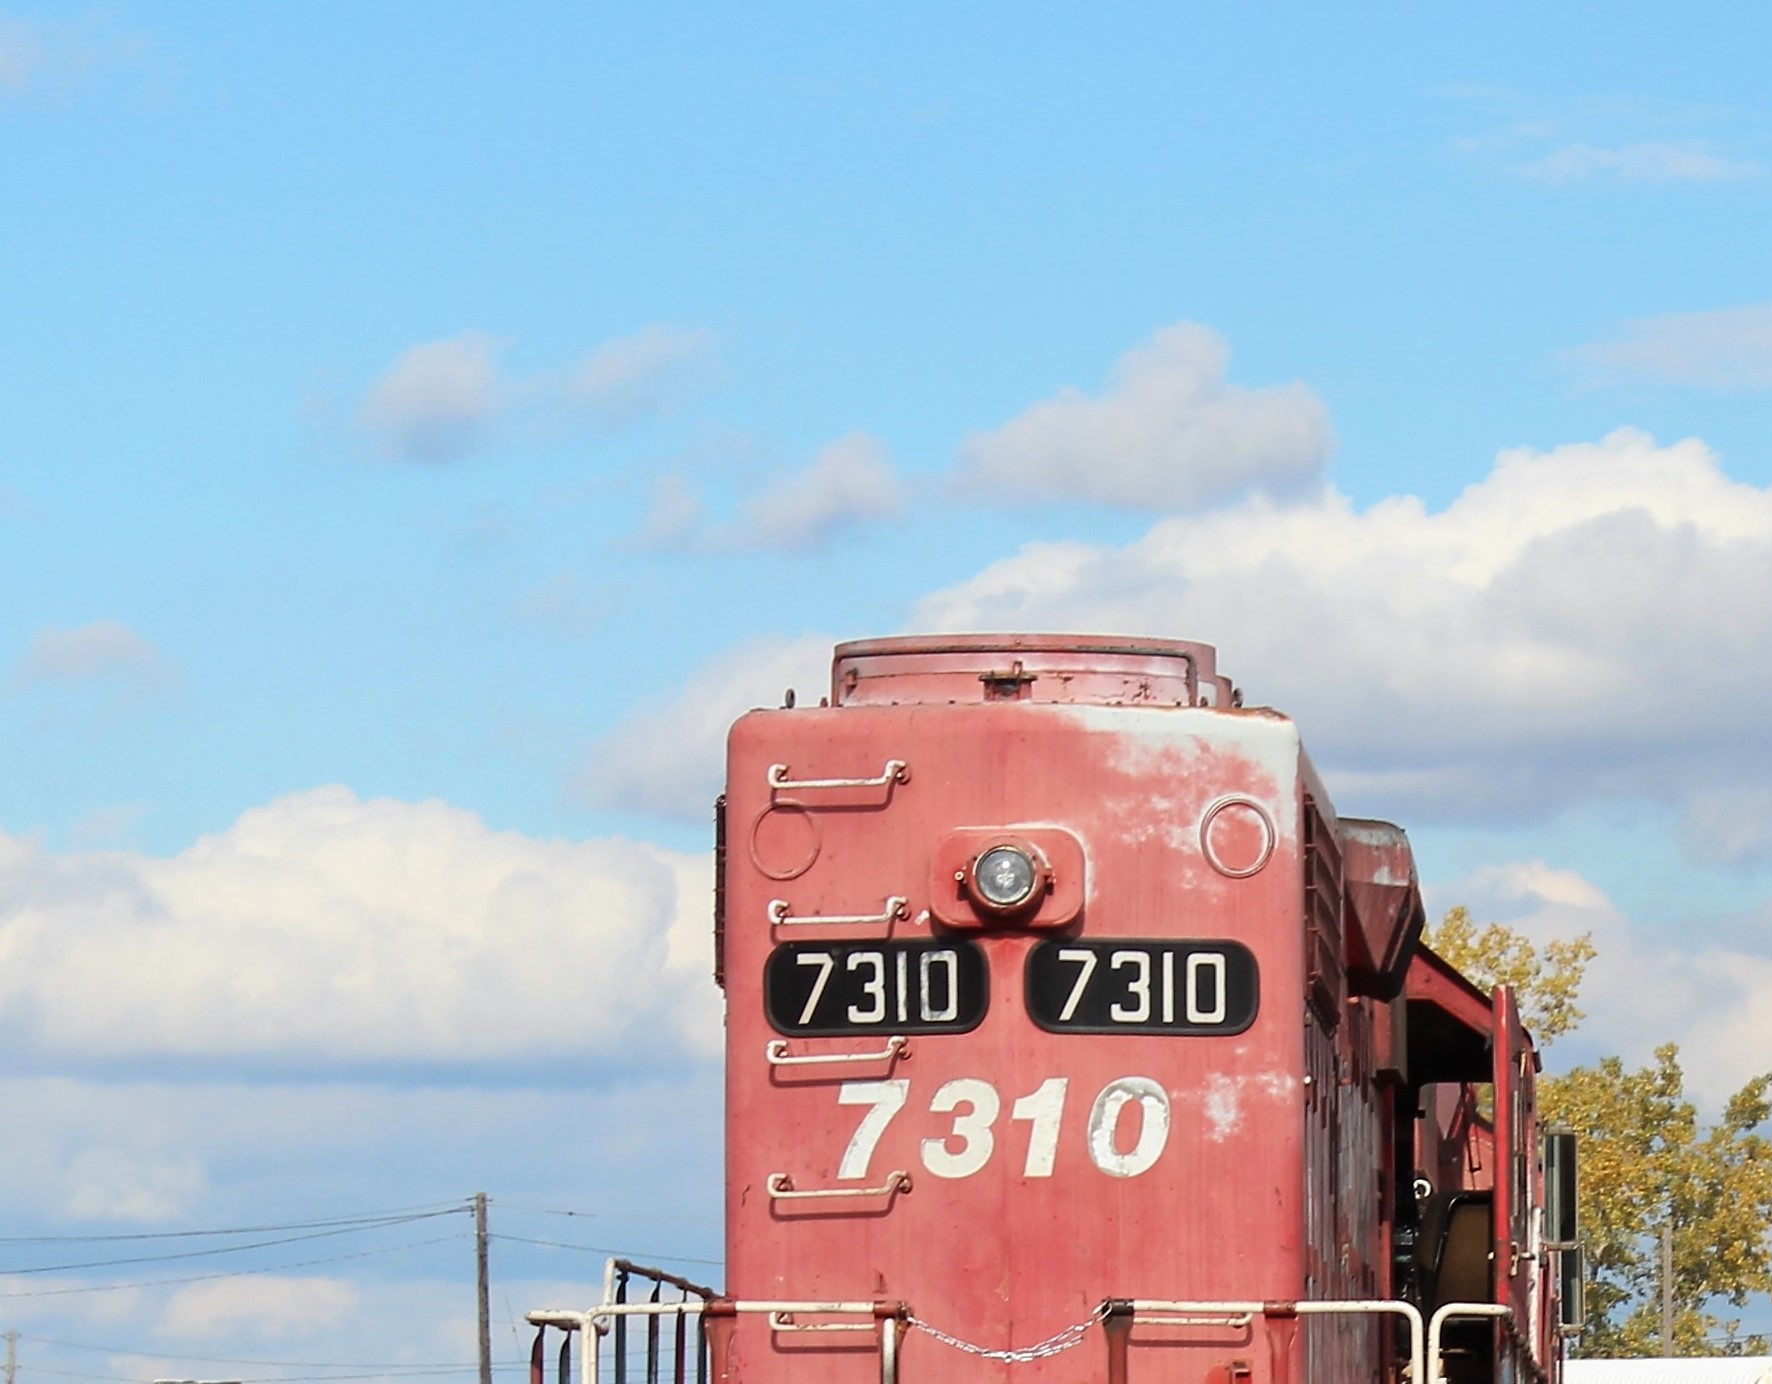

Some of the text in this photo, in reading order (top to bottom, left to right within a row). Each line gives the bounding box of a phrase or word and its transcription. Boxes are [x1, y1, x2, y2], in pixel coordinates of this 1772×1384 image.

[796, 949, 957, 1025] 7310
[1058, 949, 1227, 1025] 7310
[837, 1076, 1171, 1180] 7310
